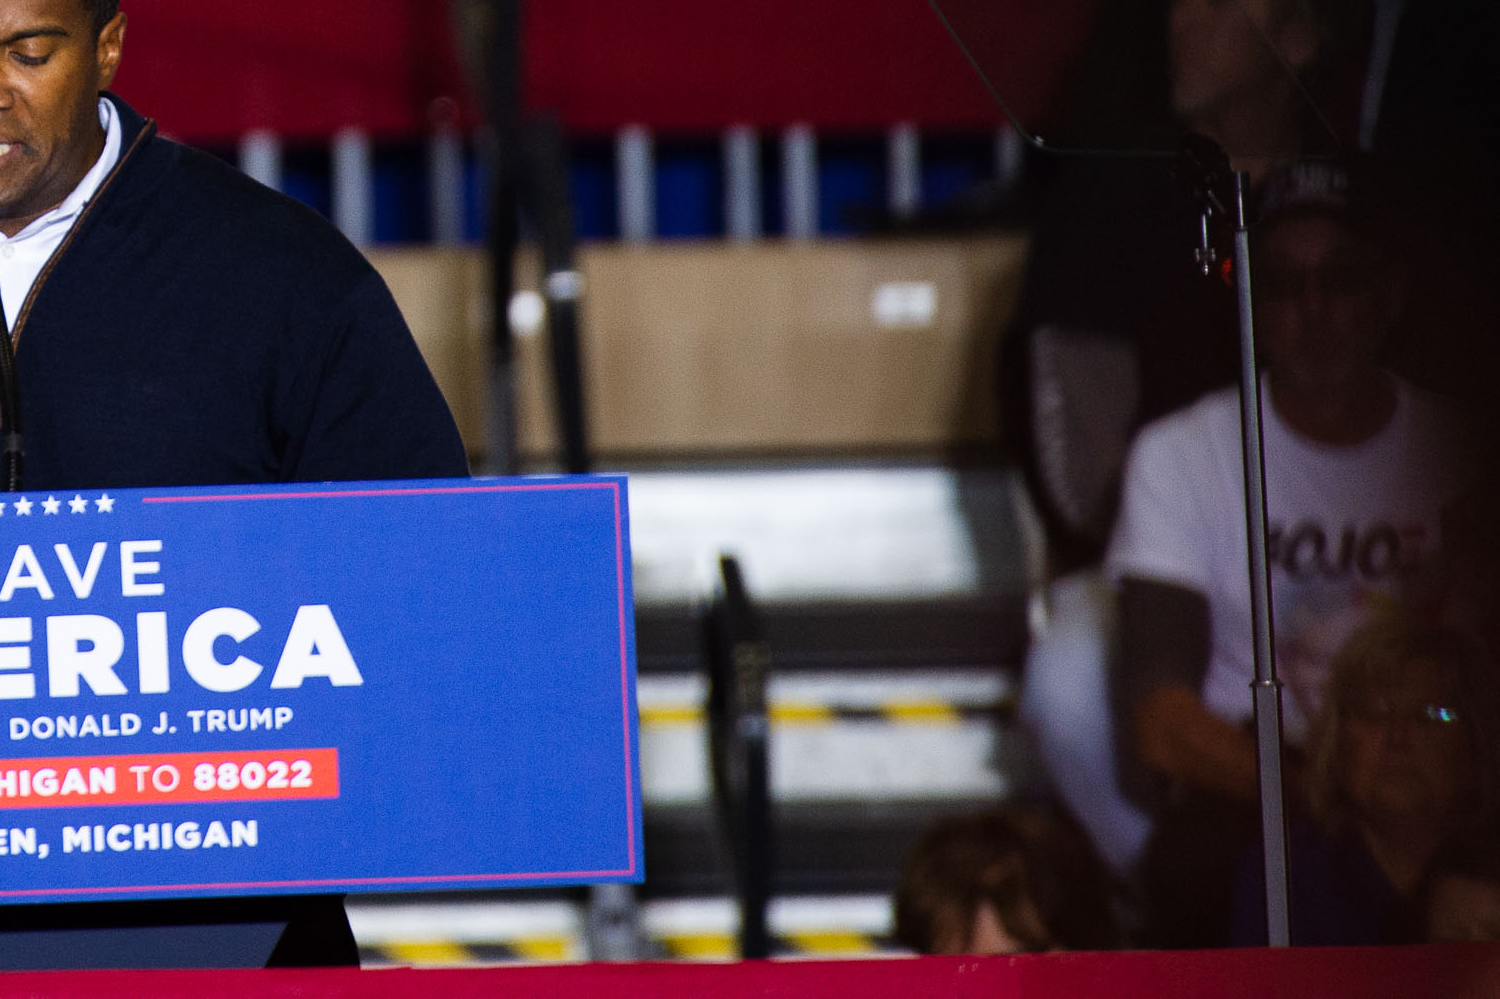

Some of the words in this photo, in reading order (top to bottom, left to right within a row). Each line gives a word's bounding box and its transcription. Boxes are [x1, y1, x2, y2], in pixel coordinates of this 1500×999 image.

[9, 713, 142, 740] DONALD
[152, 711, 177, 735] J.
[186, 706, 293, 733] TRUMP
[128, 764, 181, 793] TO
[193, 760, 313, 792] 88022
[62, 819, 258, 853] MICHIGAN
